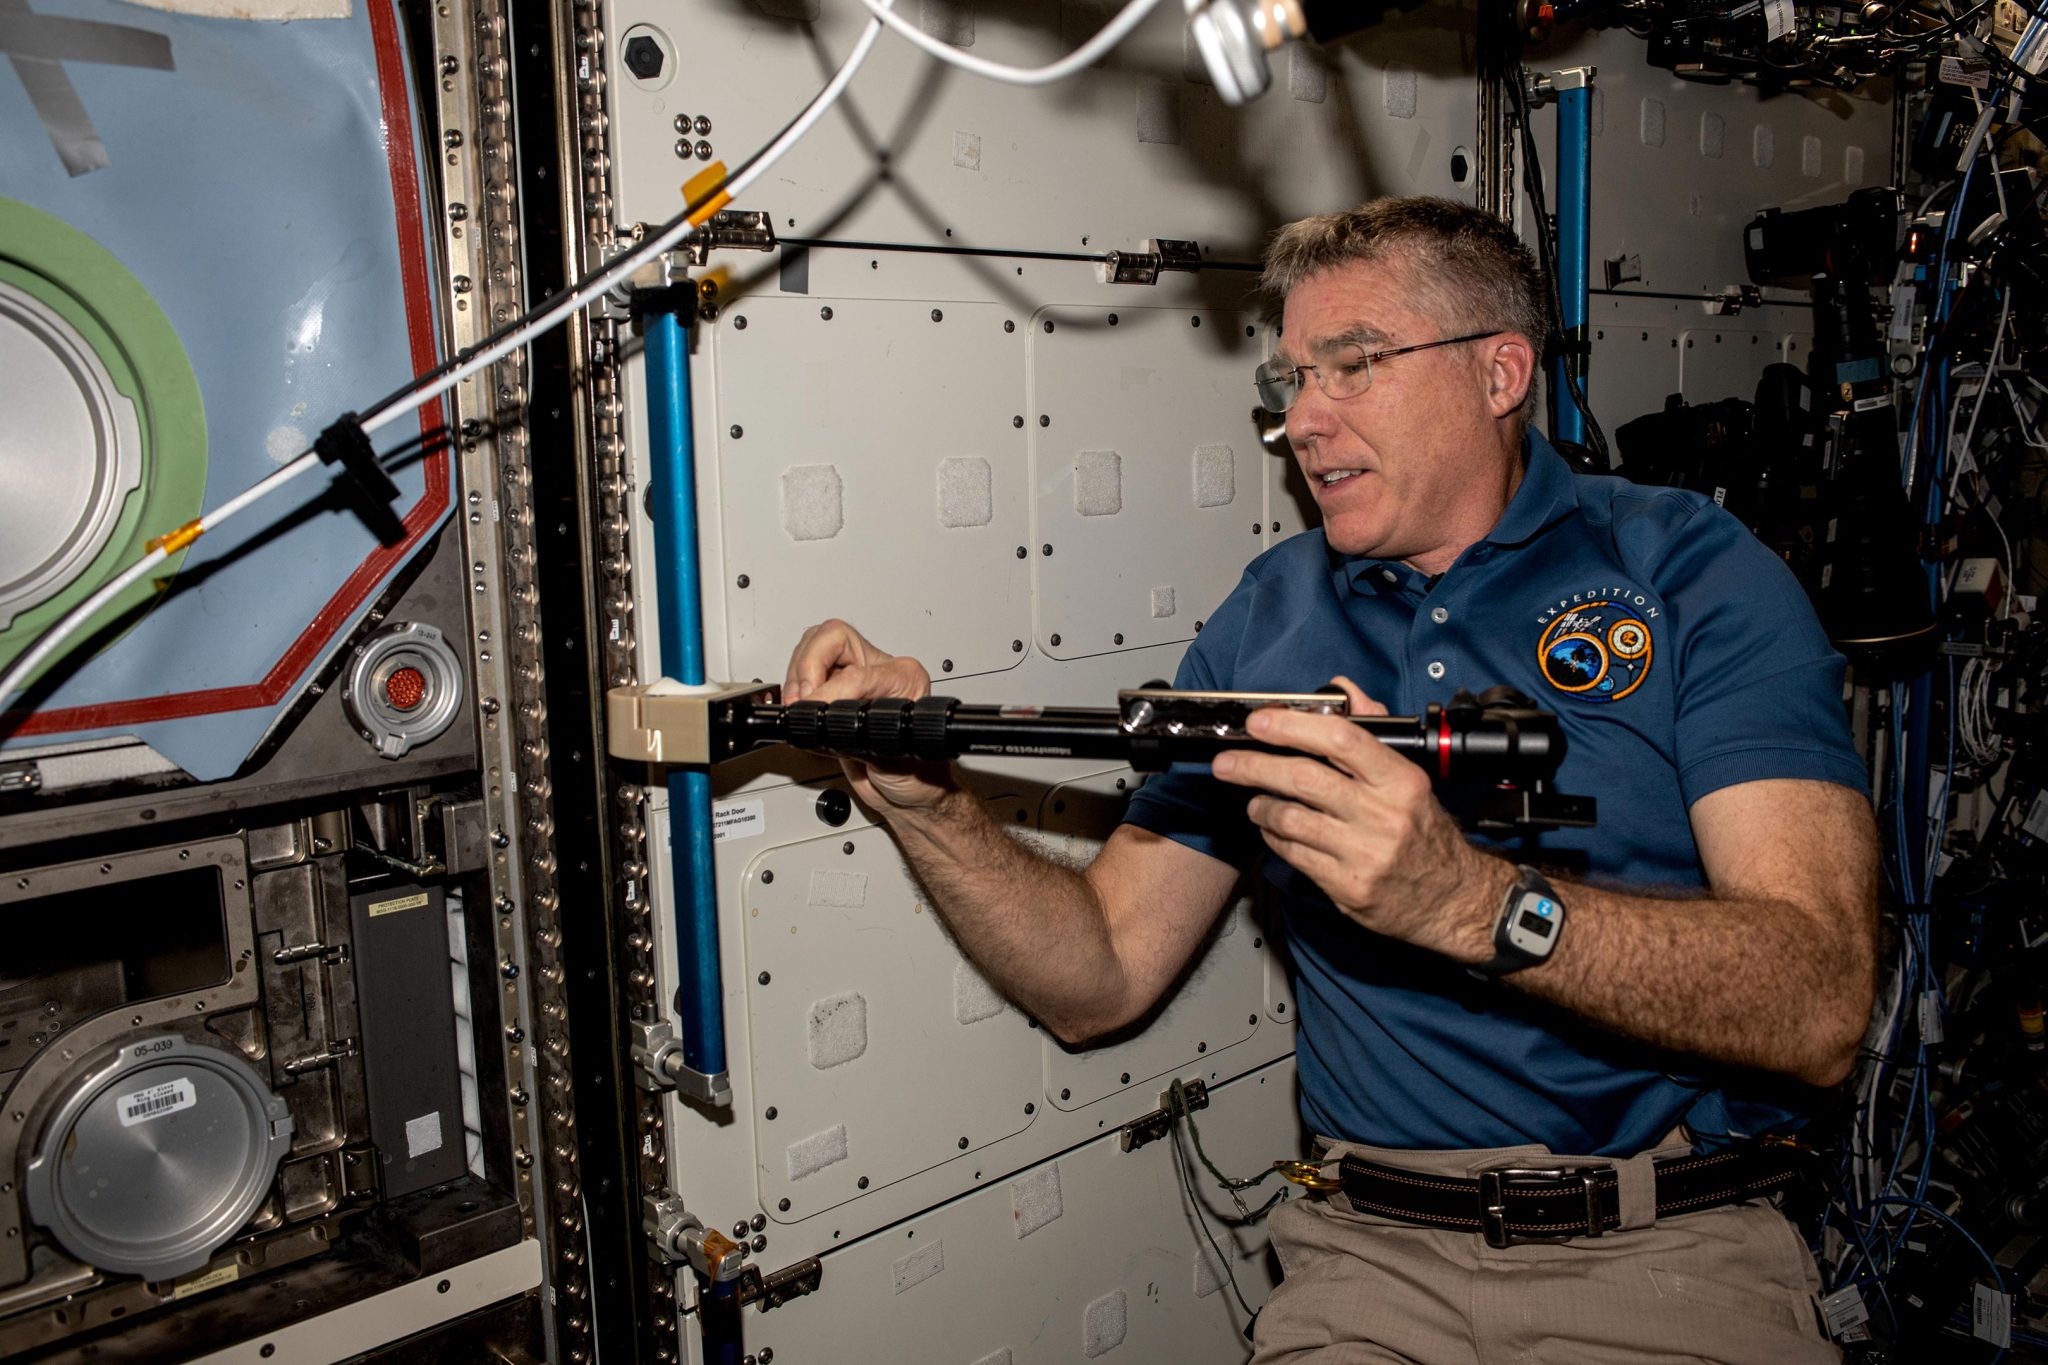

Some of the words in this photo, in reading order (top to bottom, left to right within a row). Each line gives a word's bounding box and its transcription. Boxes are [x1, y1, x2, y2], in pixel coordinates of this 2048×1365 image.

[1537, 587, 1660, 624] EXPEDITION
[1005, 744, 1072, 755] Manfrotto
[715, 810, 730, 818] Rack
[134, 1039, 174, 1057] 05-039
[157, 1084, 174, 1092] Glove
[136, 1095, 151, 1103] Ring
[153, 1088, 174, 1098] Closed
